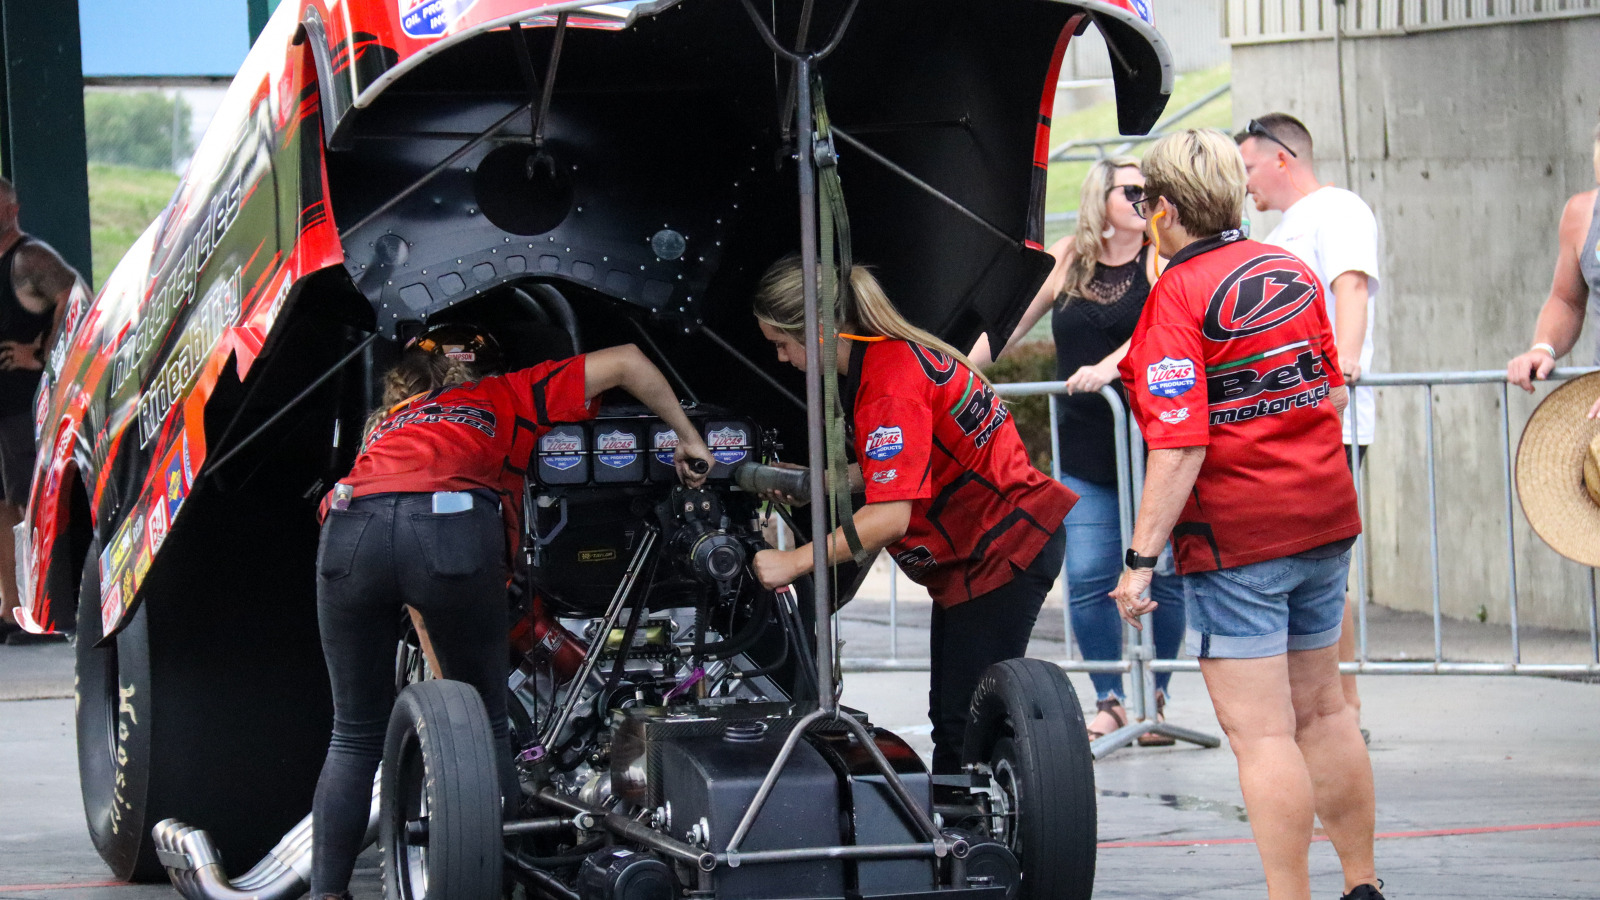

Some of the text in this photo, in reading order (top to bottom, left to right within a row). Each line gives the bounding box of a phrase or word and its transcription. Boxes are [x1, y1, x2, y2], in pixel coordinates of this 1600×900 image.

[405, 13, 421, 29] OIL
[110, 168, 242, 398] motorcycles
[137, 265, 243, 451] Rideability
[1151, 367, 1192, 382] LUCAS
[1160, 380, 1194, 389] PRODUCTS
[1209, 381, 1331, 425] motorcycl
[547, 442, 577, 451] LUCAS
[603, 440, 633, 449] LUCAS
[713, 436, 743, 446] LUCAS
[869, 434, 900, 449] LUCAS
